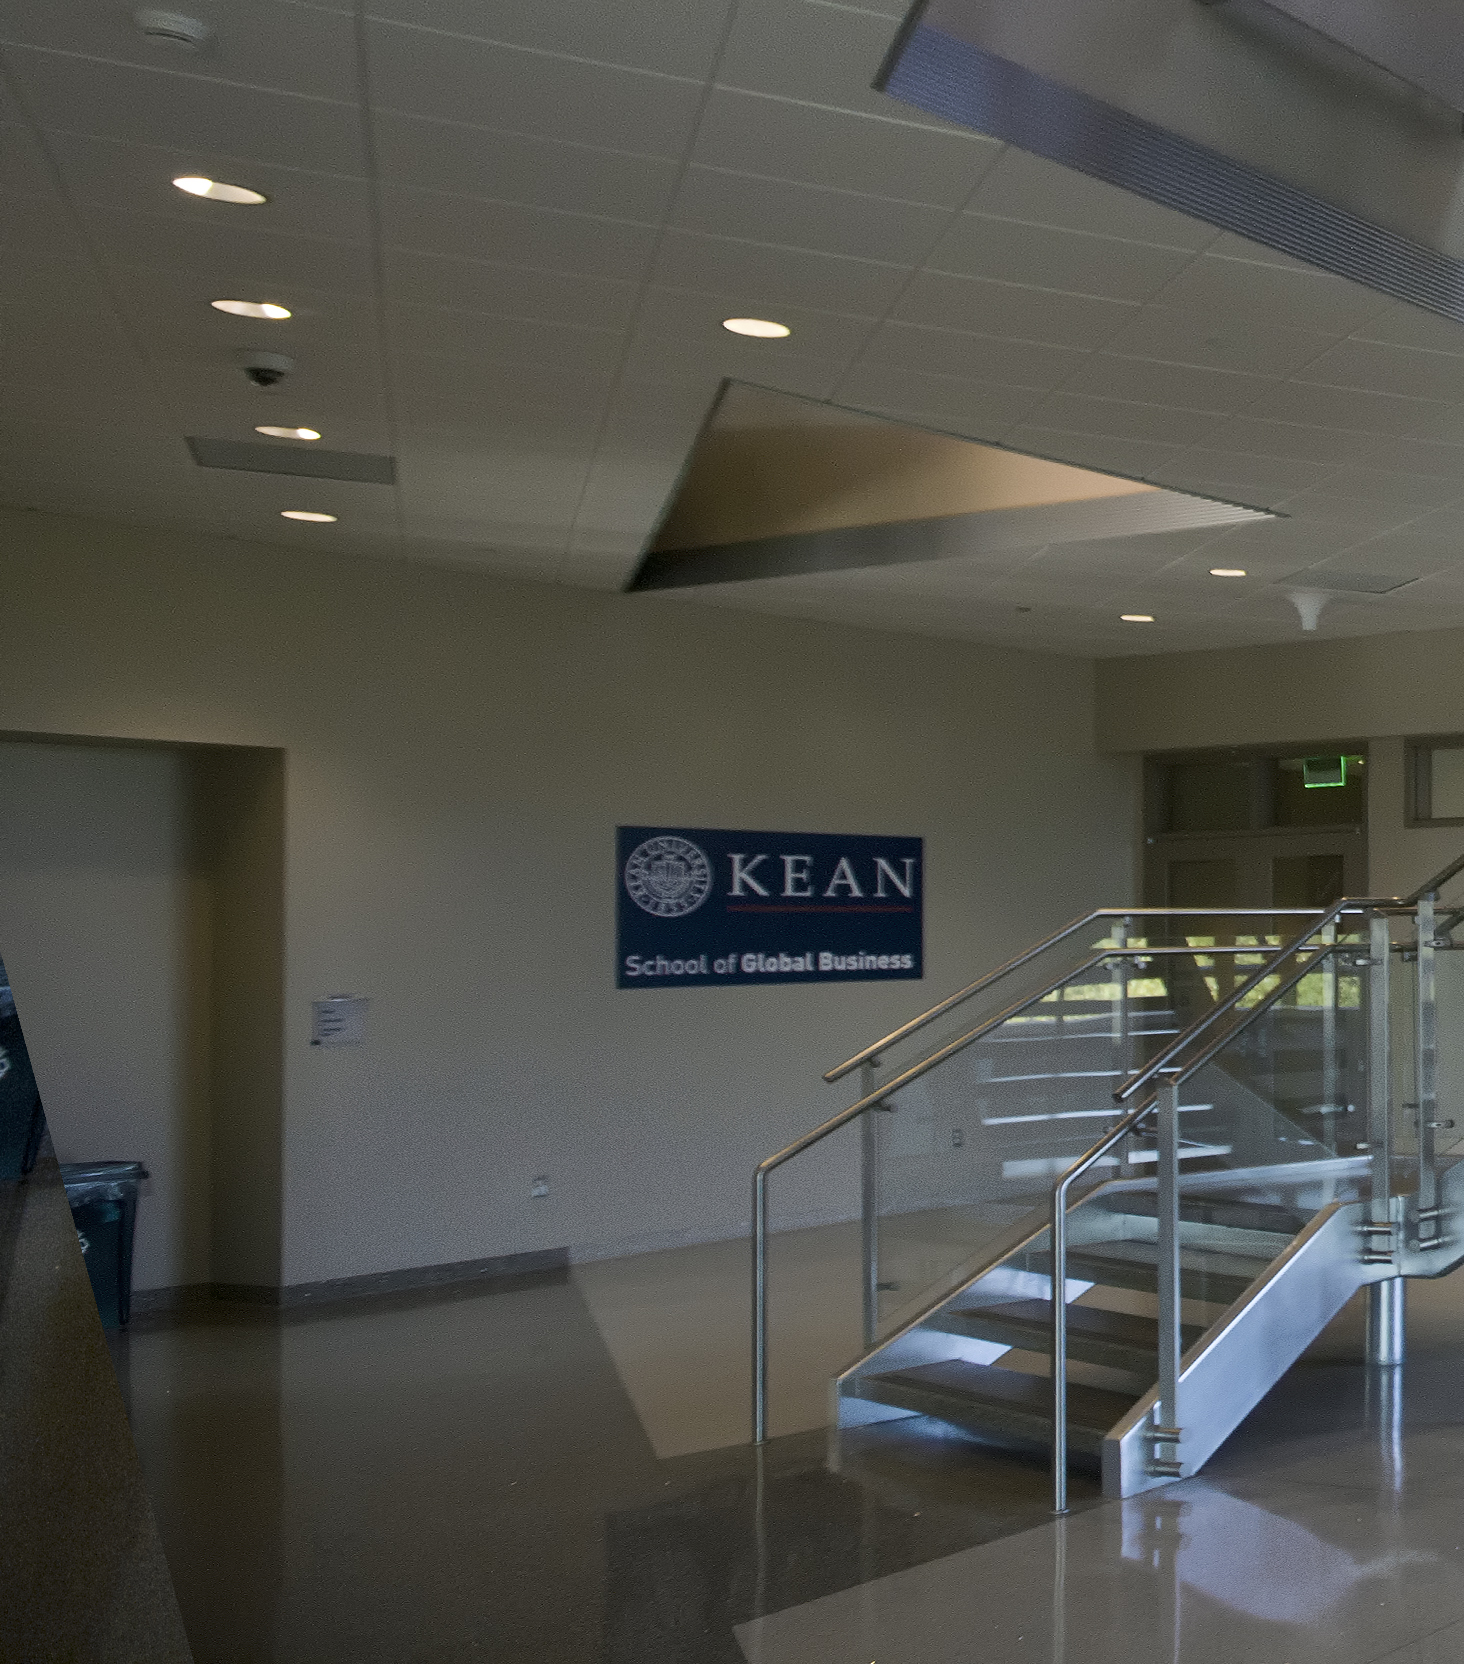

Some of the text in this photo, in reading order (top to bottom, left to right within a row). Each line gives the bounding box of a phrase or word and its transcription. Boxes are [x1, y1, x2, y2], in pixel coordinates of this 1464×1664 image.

[727, 853, 916, 898] KEAN
[625, 950, 914, 976] School of Global Business
